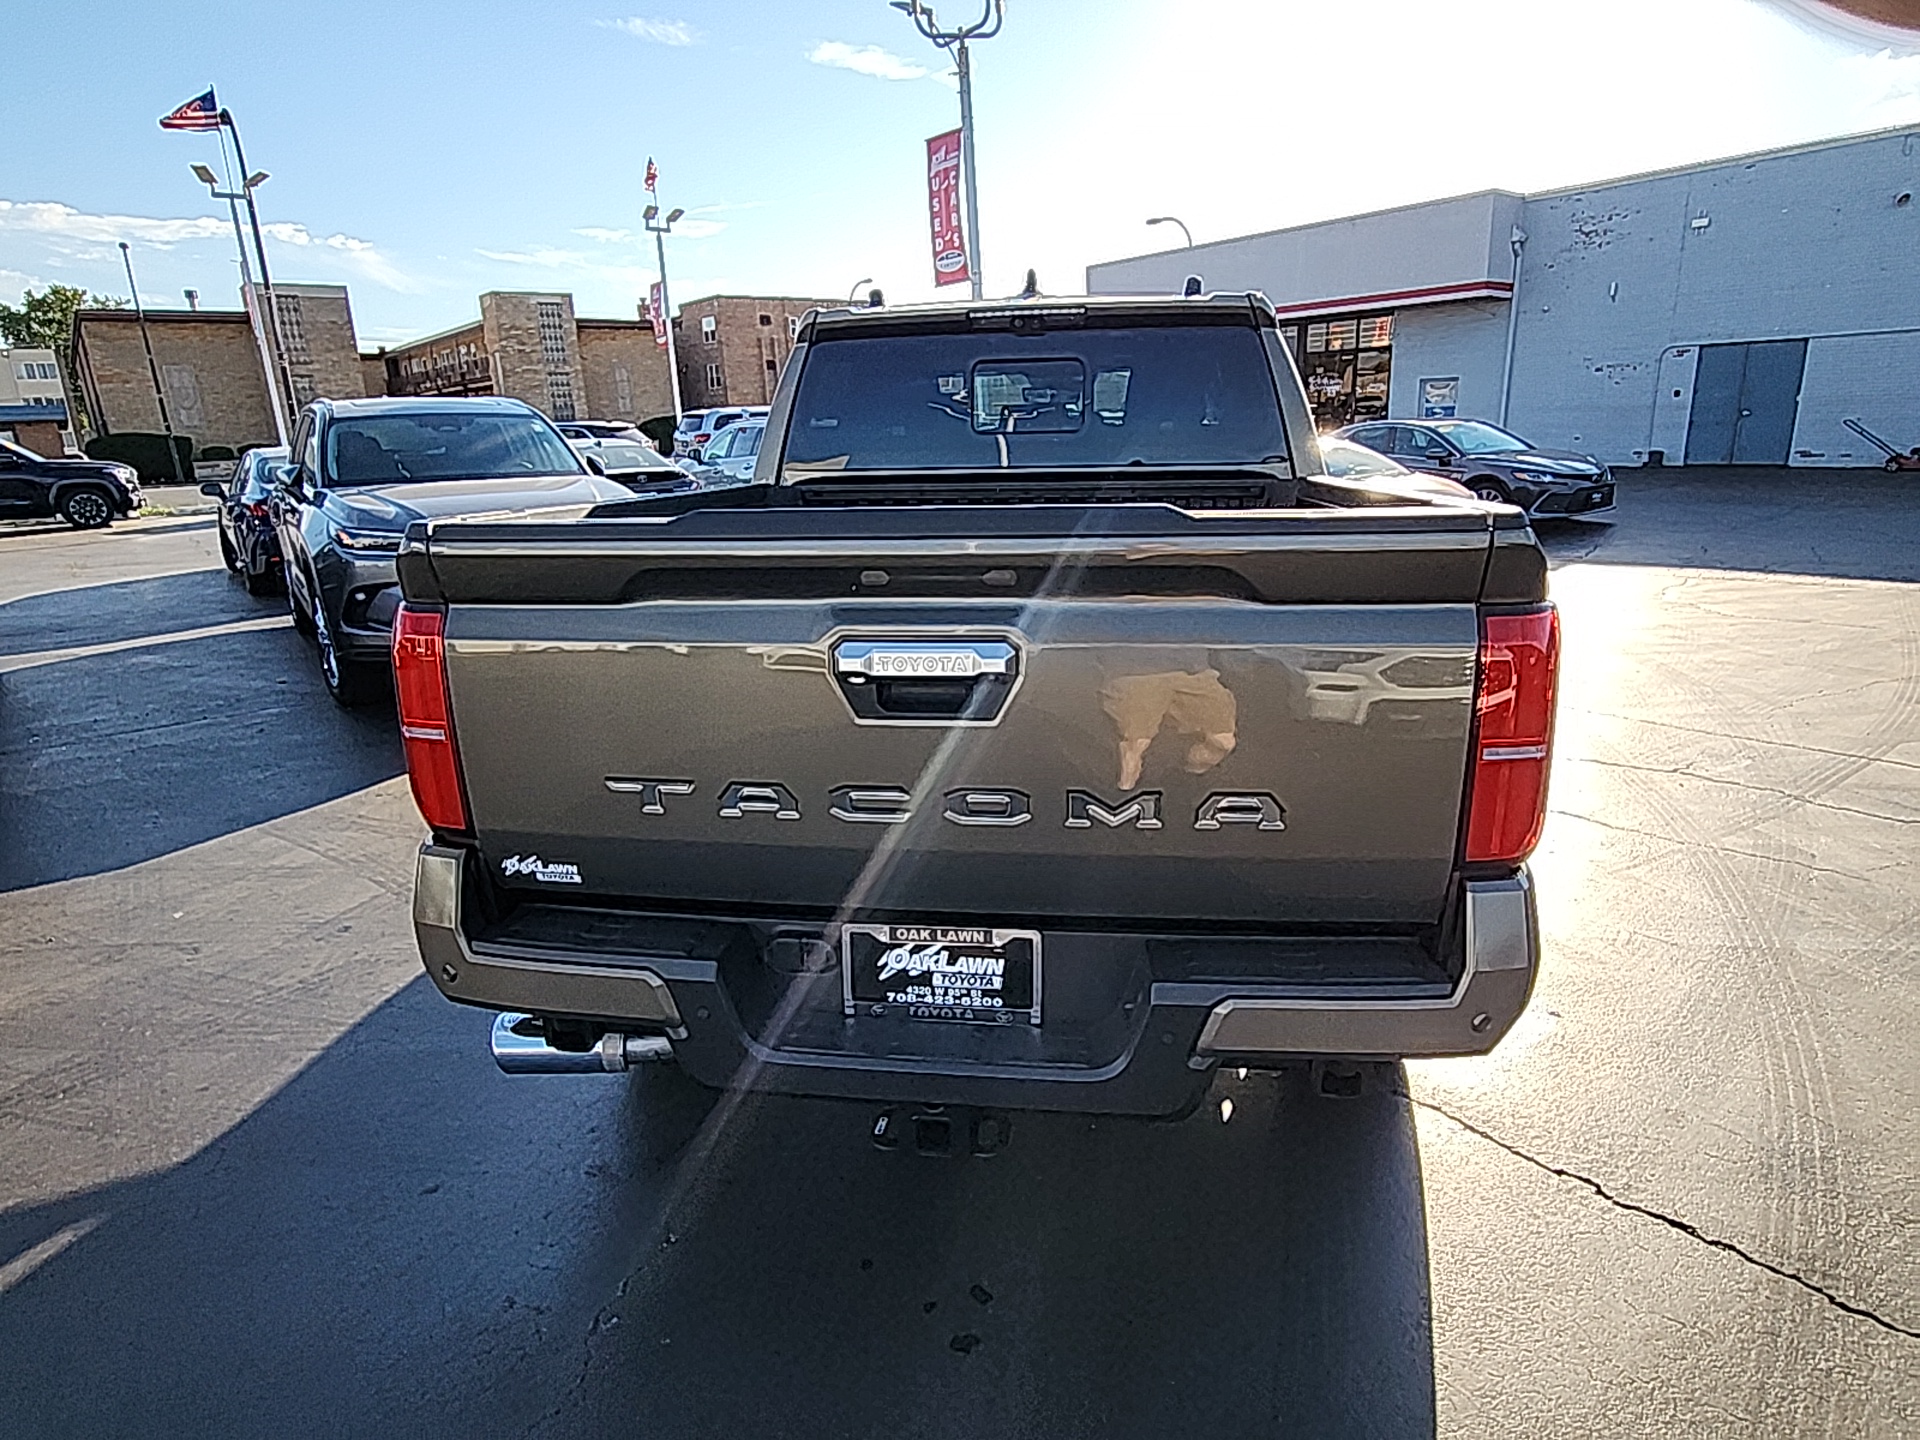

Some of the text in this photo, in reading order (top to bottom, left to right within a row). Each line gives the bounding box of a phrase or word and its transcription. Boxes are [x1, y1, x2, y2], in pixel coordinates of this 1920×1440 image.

[878, 655, 969, 673] TOYOTA
[604, 776, 1287, 831] TACOMA
[896, 928, 985, 943] OAK LAWN
[940, 974, 997, 988] TOYOTA
[906, 985, 931, 995] 4320
[934, 987, 945, 996] W
[909, 1006, 975, 1019] TOYOTA
